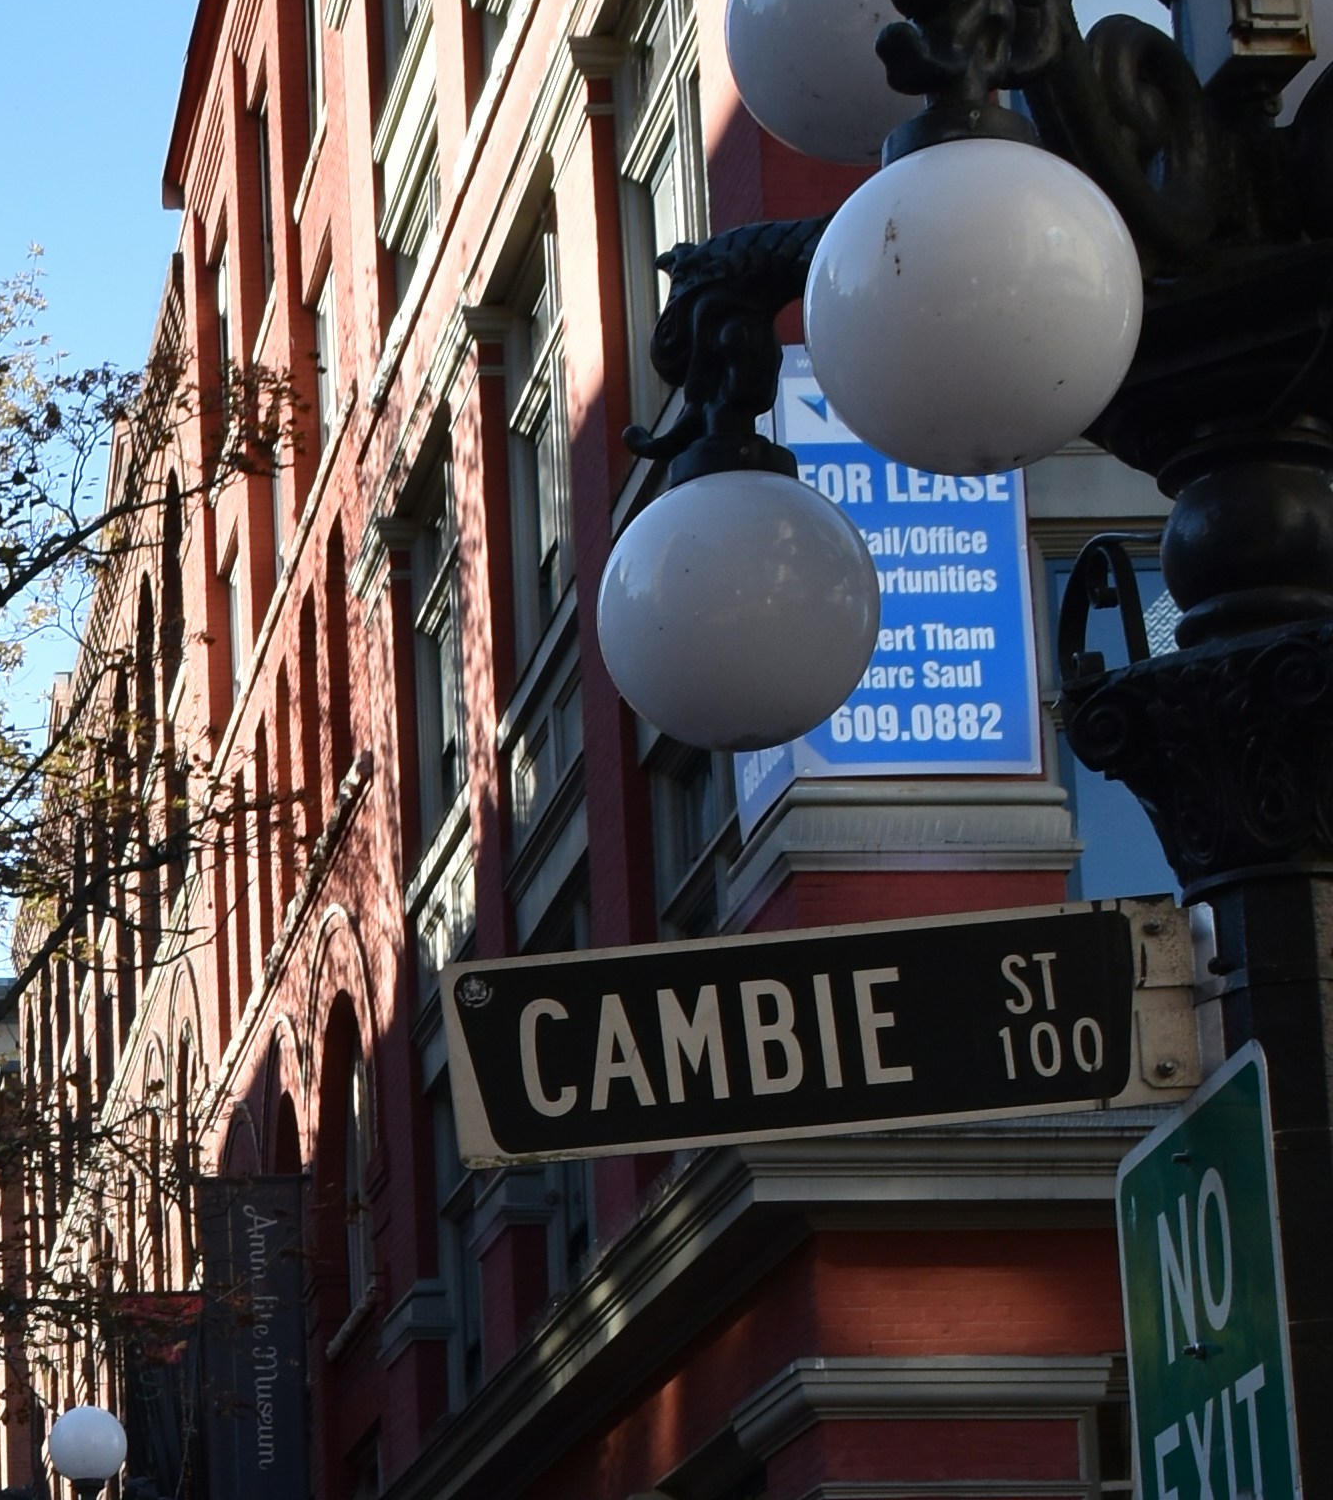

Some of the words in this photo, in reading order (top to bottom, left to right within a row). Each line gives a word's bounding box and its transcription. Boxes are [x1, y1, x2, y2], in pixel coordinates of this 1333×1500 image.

[798, 462, 873, 504] FOR
[886, 466, 1010, 503] LEASE
[921, 622, 996, 651] Tham
[921, 660, 982, 689] Saul
[518, 966, 914, 1118] CAMBIE
[1000, 950, 1061, 1015] ST
[997, 1019, 1105, 1081] 100
[1156, 1164, 1234, 1367] NO
[252, 1345, 279, 1471] Museum
